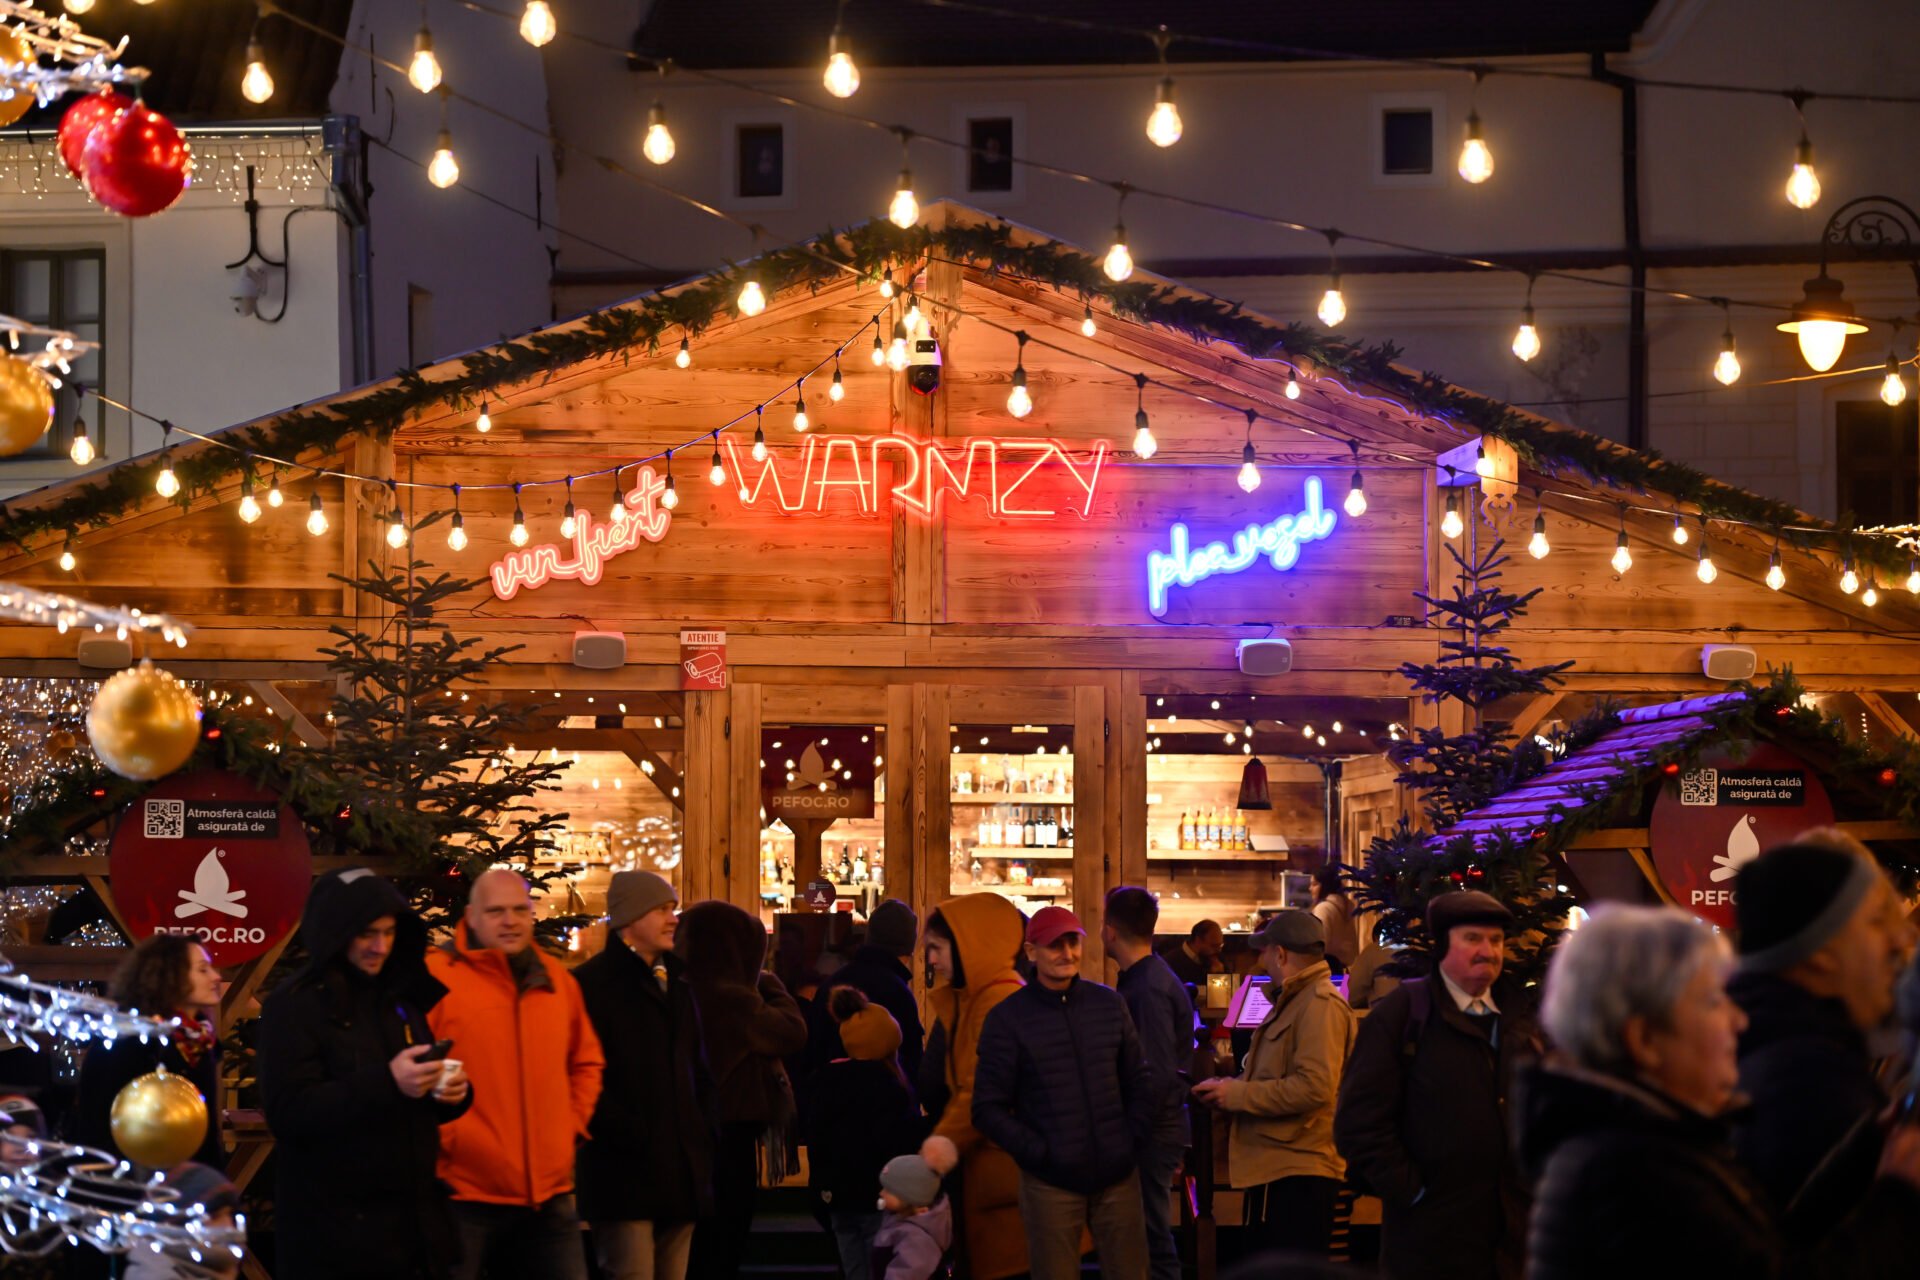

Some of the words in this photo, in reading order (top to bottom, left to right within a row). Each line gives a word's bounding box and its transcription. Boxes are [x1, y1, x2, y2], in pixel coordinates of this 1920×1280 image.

[725, 436, 1106, 516] WARMZY
[493, 546, 568, 598] vin
[575, 467, 671, 584] fiert
[1720, 776, 1772, 786] Atmosferă
[1730, 789, 1776, 801] asigurată
[1778, 789, 1792, 799] de
[772, 796, 849, 808] PEFOC.RO
[186, 808, 244, 819] Atmosferă
[197, 821, 249, 833] asigurată
[250, 822, 265, 832] de
